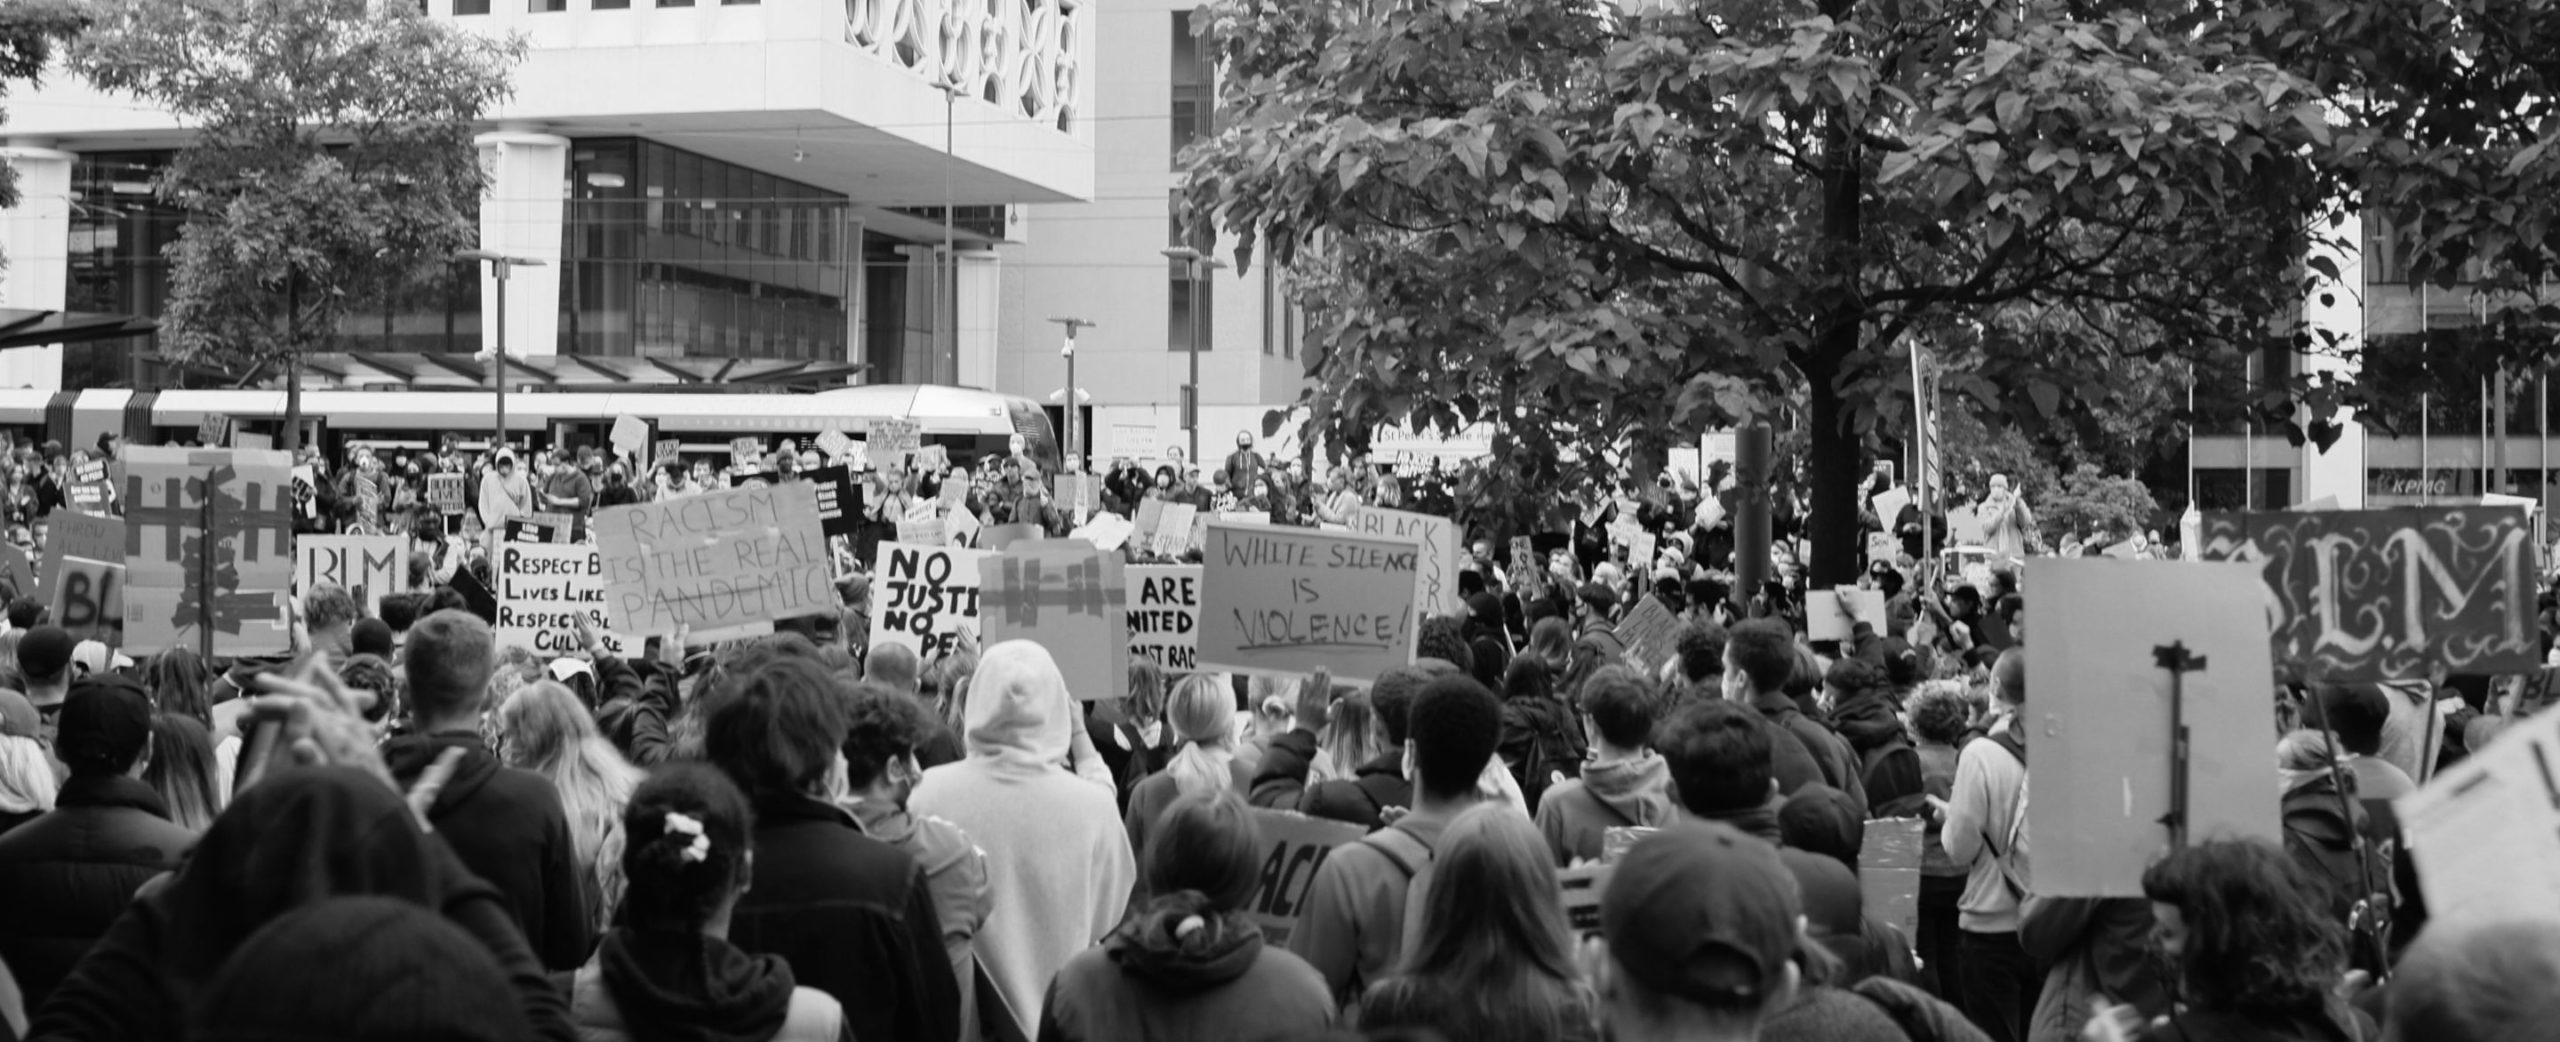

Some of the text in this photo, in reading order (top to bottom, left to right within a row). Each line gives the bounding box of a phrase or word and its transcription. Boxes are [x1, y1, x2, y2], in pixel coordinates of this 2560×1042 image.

[1436, 430, 1472, 443] Suare
[431, 490, 463, 501] LIVES
[2392, 479, 2446, 494] KPMG
[628, 493, 779, 542] RACISM
[503, 548, 583, 575] RESPECT
[608, 531, 820, 585] IS THE REAL
[1223, 531, 1317, 568] WHITE
[1327, 544, 1419, 573] SILENCE
[888, 548, 952, 586] NO
[505, 578, 605, 603] LIVES LIKE
[1140, 576, 1197, 607] ARE
[1292, 577, 1320, 604] IS
[499, 606, 578, 629] RESPECT
[883, 610, 933, 636] NO
[1233, 604, 1410, 646] VIOLENCE!
[534, 630, 623, 653] CULRE
